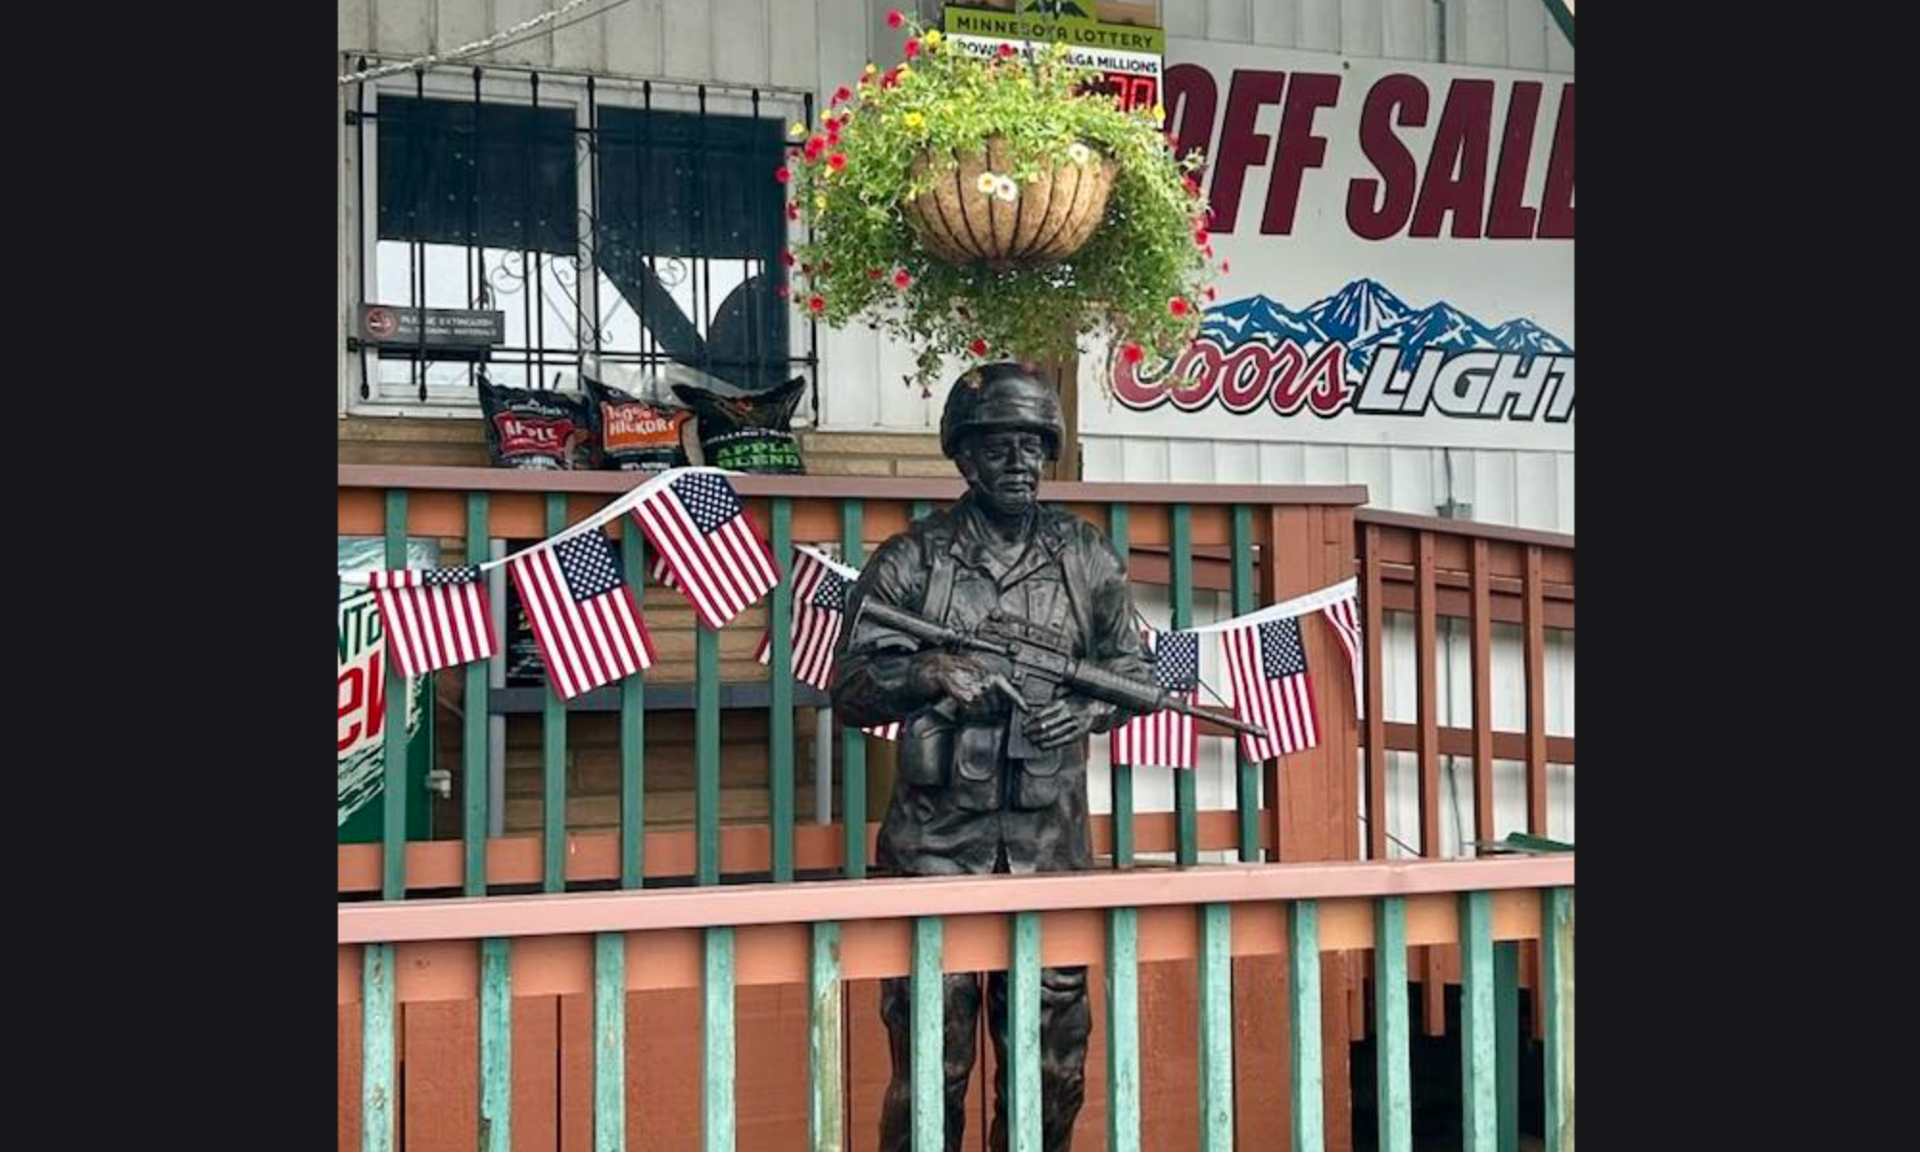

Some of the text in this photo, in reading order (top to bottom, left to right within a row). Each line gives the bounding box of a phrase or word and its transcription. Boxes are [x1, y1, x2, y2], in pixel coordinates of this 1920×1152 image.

[1074, 28, 1153, 49] LOTTERY
[1098, 56, 1158, 74] MILLIONS
[1164, 63, 1342, 236] OFF
[1109, 338, 1352, 418] Coors
[608, 417, 675, 437] HICKORY
